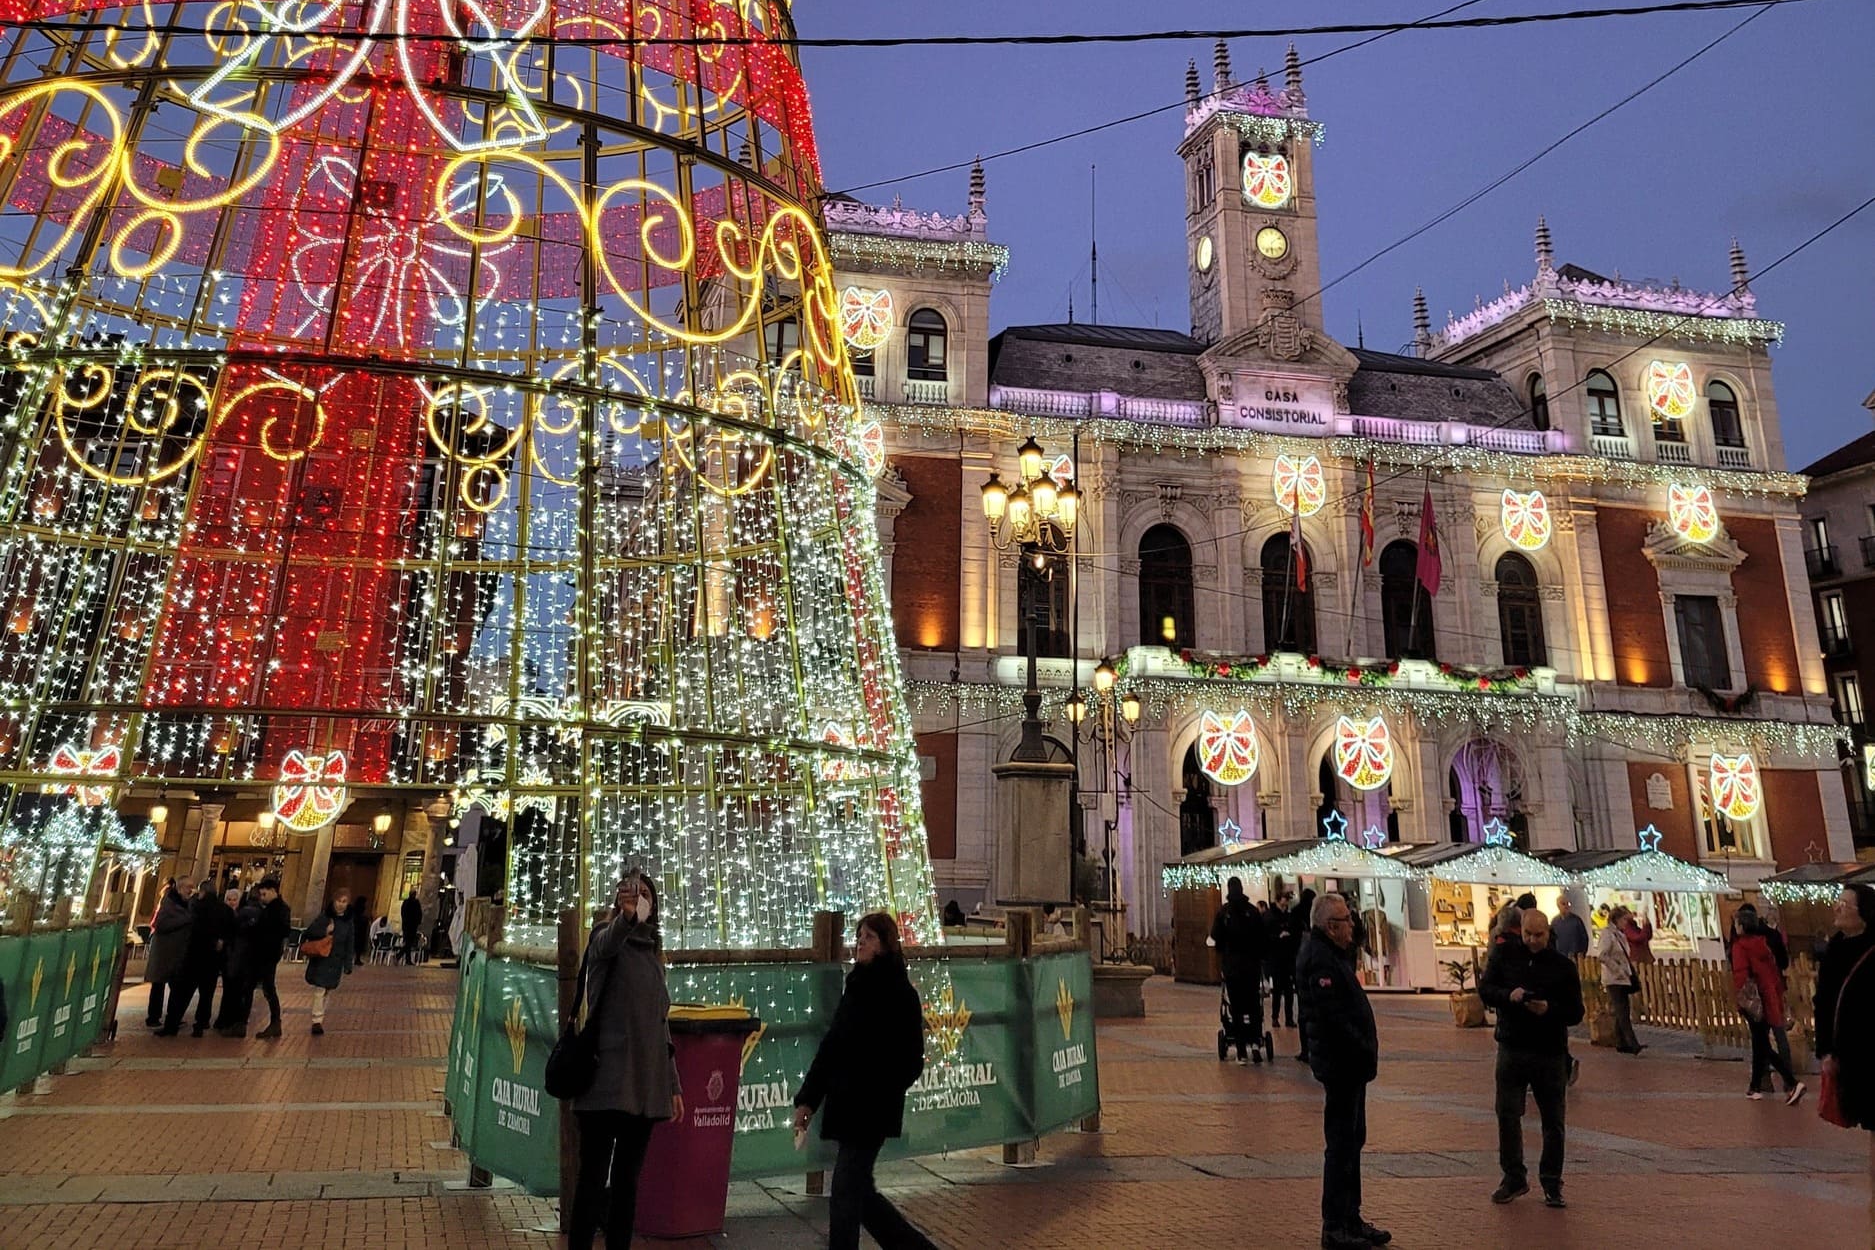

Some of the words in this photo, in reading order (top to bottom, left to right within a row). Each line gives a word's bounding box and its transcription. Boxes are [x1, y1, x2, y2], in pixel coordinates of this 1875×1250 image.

[1265, 390, 1299, 403] CASA
[1240, 406, 1327, 425] CONSISTORIAL
[943, 1062, 997, 1089] RURAL
[492, 1077, 511, 1107] CAJA
[513, 1083, 541, 1117] RURAL
[919, 1096, 933, 1111] DE
[936, 1090, 980, 1109] ZAMORA
[498, 1108, 506, 1127] DE
[507, 1110, 531, 1136] ZAMORA
[694, 1114, 730, 1126] Valladolid
[734, 1112, 775, 1132] MORA
